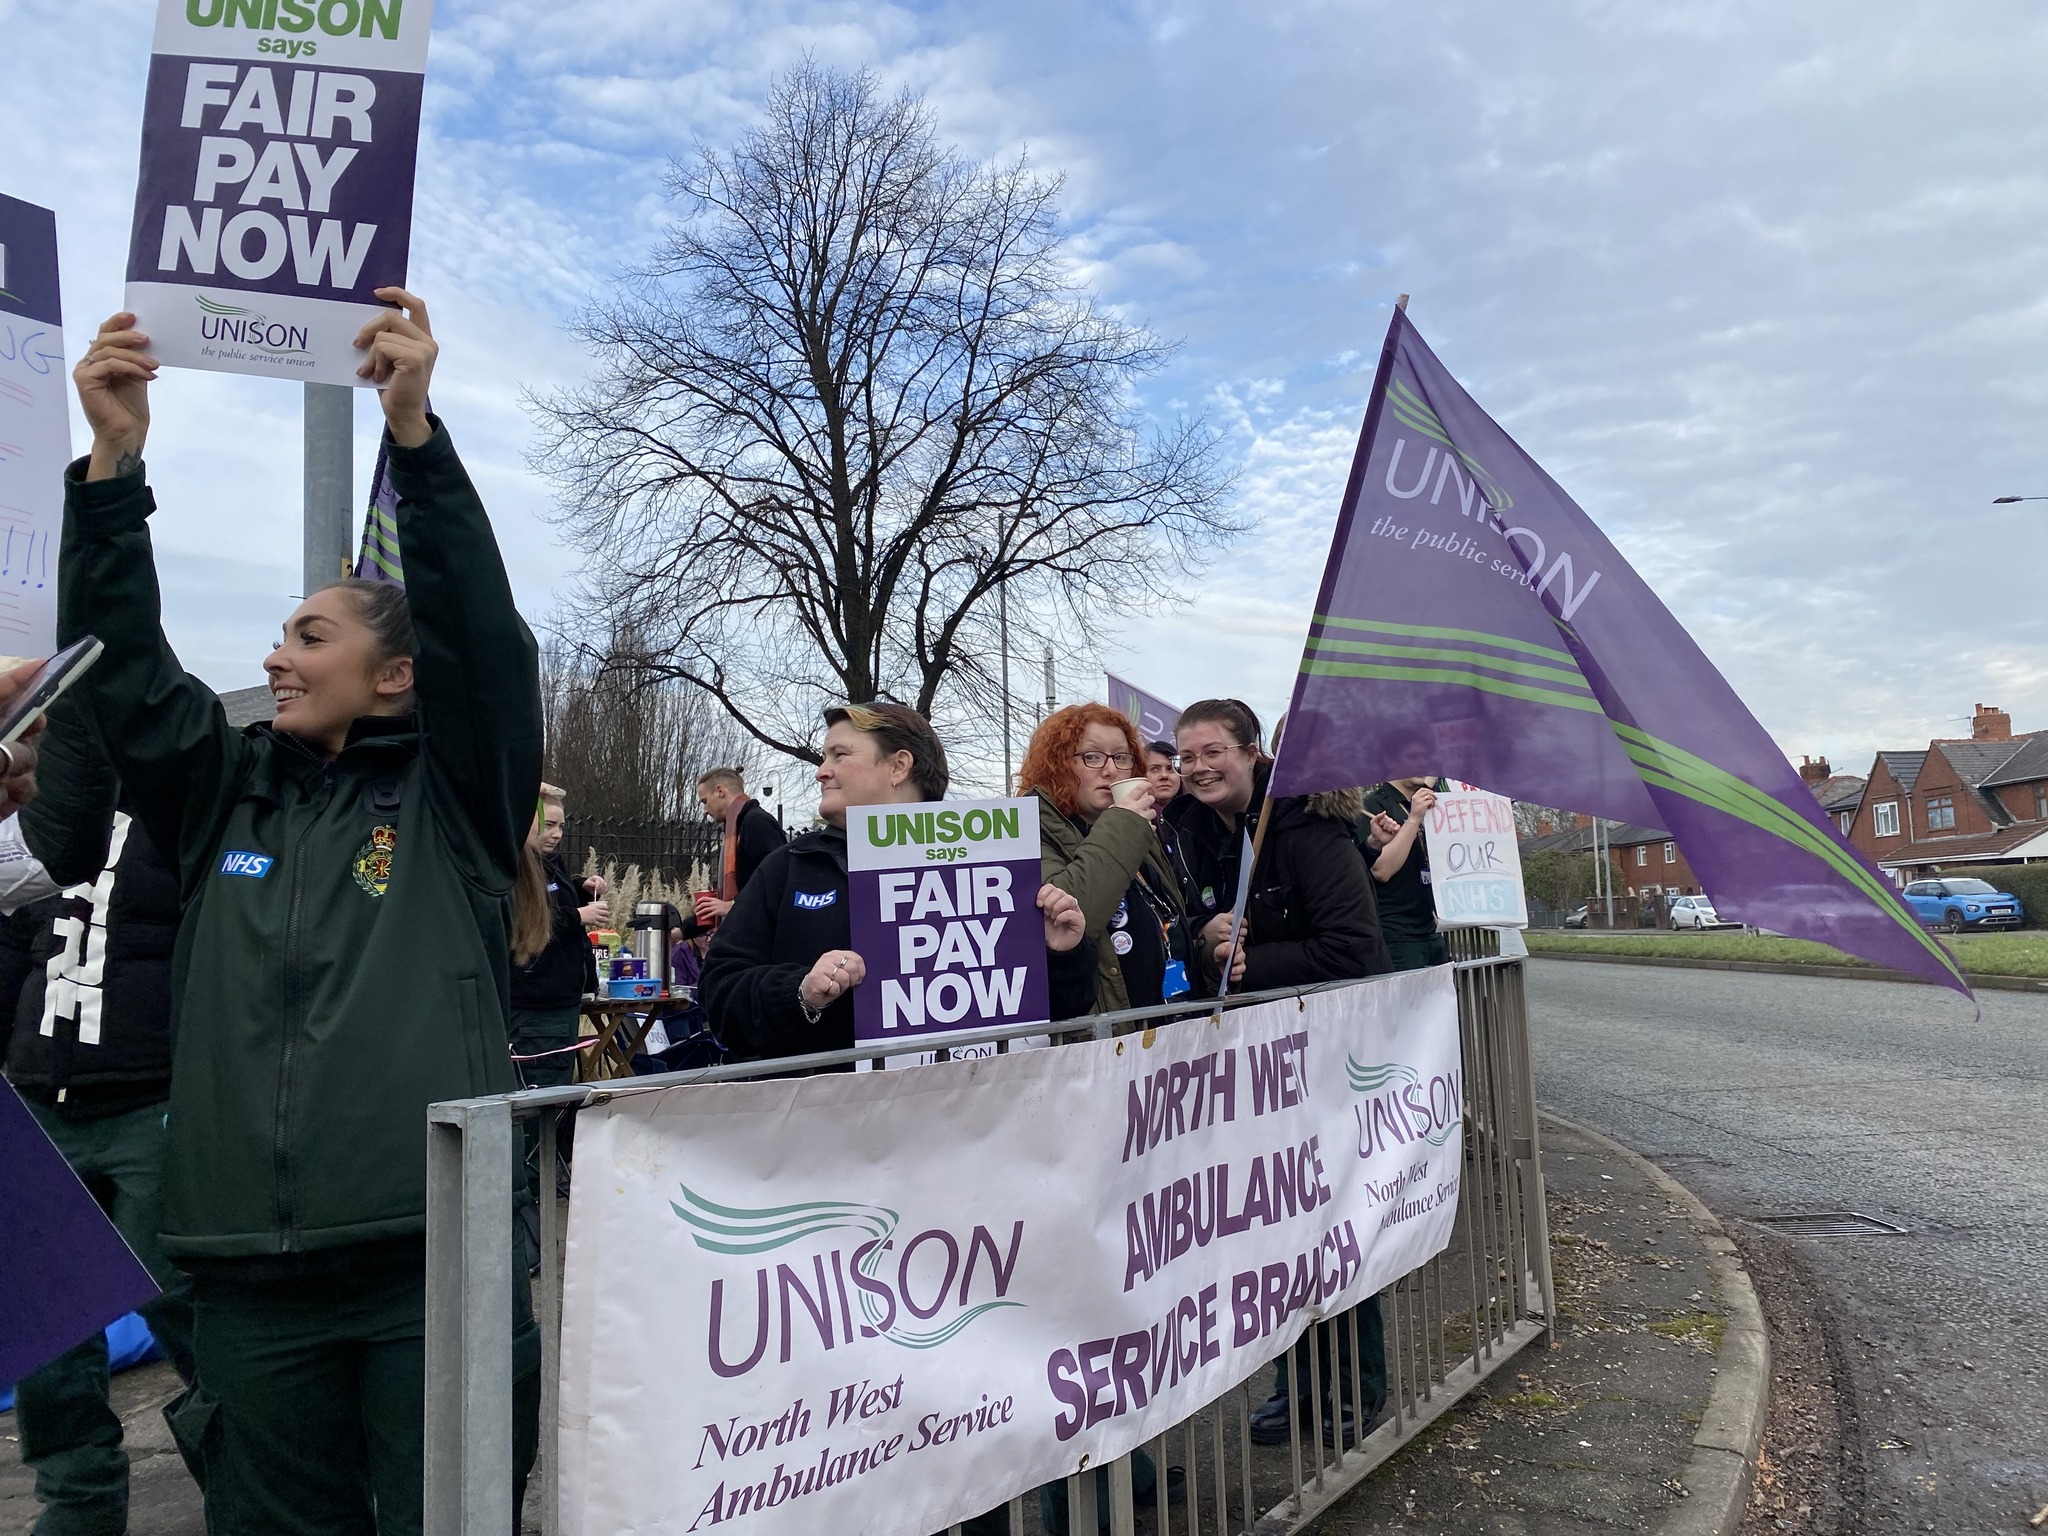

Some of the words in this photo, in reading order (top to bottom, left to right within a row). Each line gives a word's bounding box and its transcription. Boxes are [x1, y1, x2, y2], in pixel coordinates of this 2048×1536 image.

[186, 0, 402, 40] UNISON
[257, 37, 317, 59] says
[180, 63, 377, 142] FAIR
[193, 136, 359, 213] PAY
[158, 205, 378, 289] NOW
[201, 316, 308, 350] UNISON
[201, 345, 216, 356] the
[217, 348, 247, 360] public
[249, 353, 284, 364] service
[286, 357, 316, 368] union
[1370, 516, 1409, 541] the
[1410, 527, 1487, 564] public
[867, 807, 1020, 848] UNISON
[1430, 799, 1513, 834] DEFEND
[221, 853, 269, 874] NHS
[925, 845, 968, 862] says
[1447, 841, 1503, 872] OUR
[798, 892, 835, 907] NHS
[878, 866, 1015, 923] FAIR
[1447, 883, 1506, 912] NHS
[898, 917, 1008, 975] PAY
[881, 966, 1028, 1030] NOW
[1122, 1048, 1236, 1164] NORTH
[1247, 1030, 1309, 1117] WET
[1354, 1069, 1459, 1158] UNISON
[1123, 1134, 1332, 1293] AMBULANCE
[1364, 1170, 1406, 1208] North
[708, 1220, 1024, 1378] UNISON
[1047, 1282, 1221, 1442] SERVICE
[691, 1398, 812, 1471] North
[826, 1373, 905, 1430] West
[686, 1433, 904, 1533] Ambulance
[906, 1393, 1014, 1454] Service
